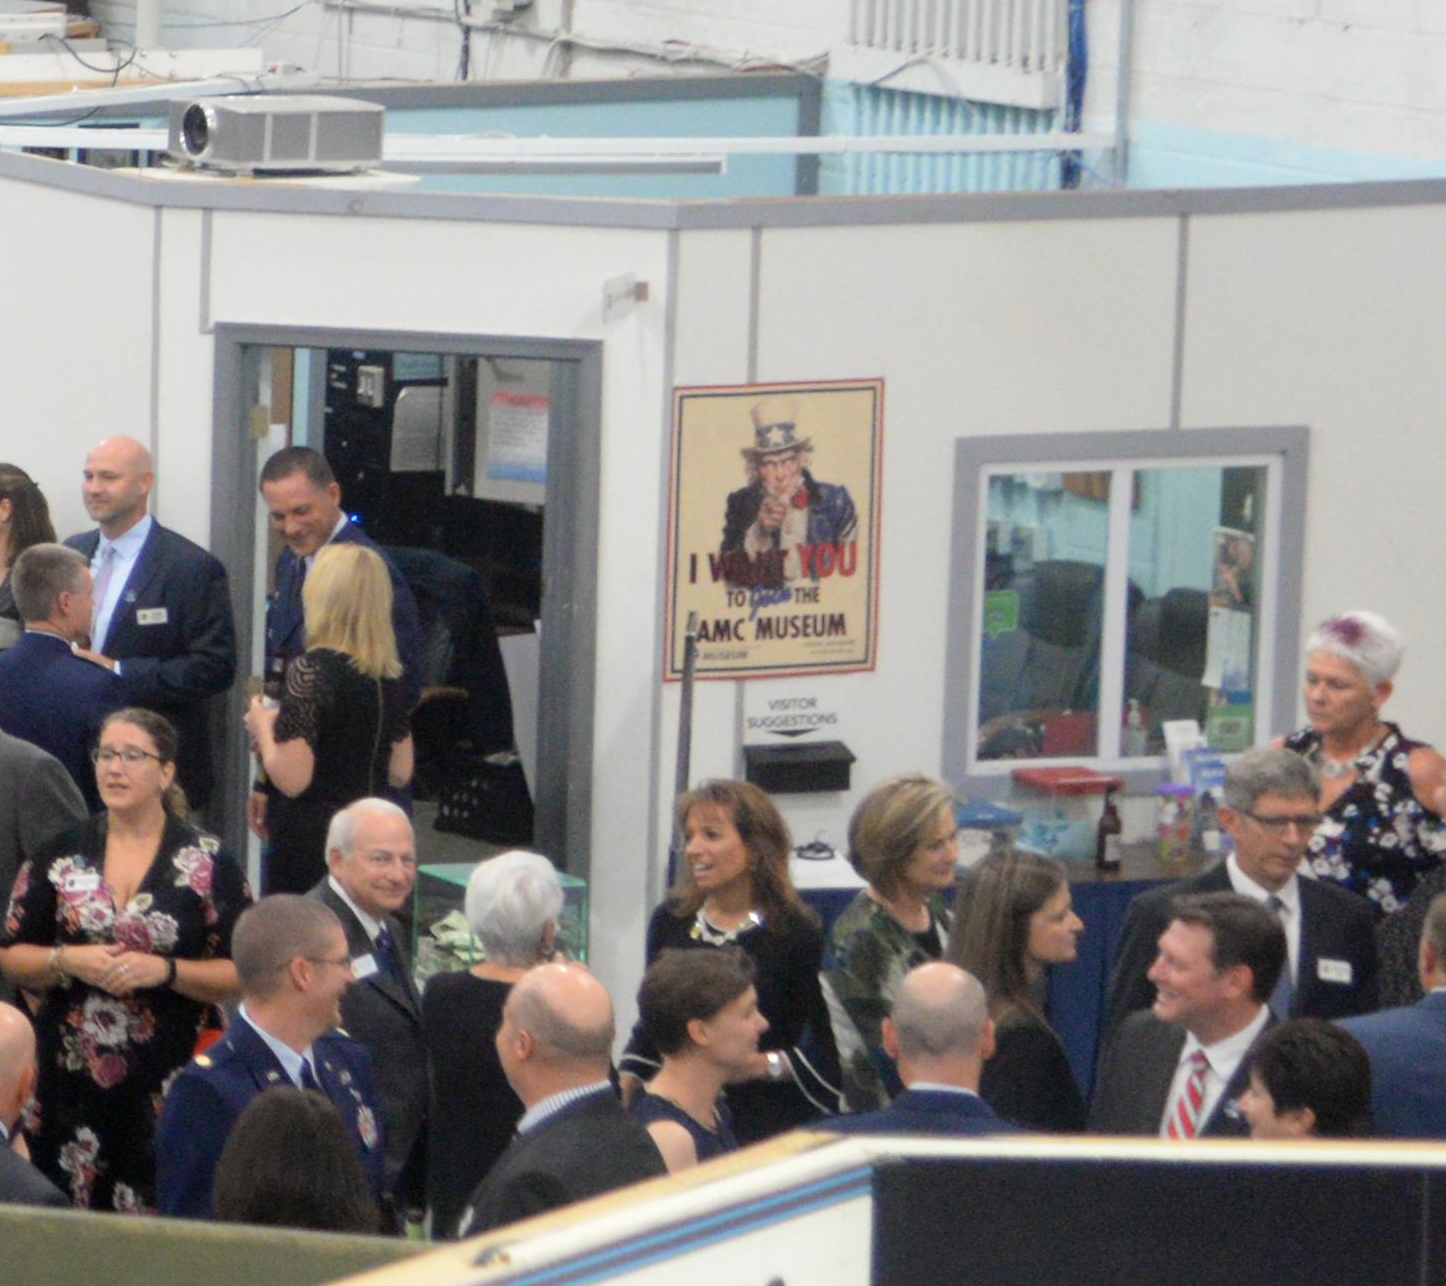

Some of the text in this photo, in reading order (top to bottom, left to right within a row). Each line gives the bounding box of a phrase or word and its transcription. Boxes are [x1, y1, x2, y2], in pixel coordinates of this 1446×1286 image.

[690, 541, 857, 583] I WANT YOU
[726, 590, 745, 607] TO
[795, 587, 820, 604] THE
[697, 613, 846, 642] AMC MUSEUM
[768, 698, 817, 710] VISITOR
[747, 713, 837, 729] SUGGESTIONS
